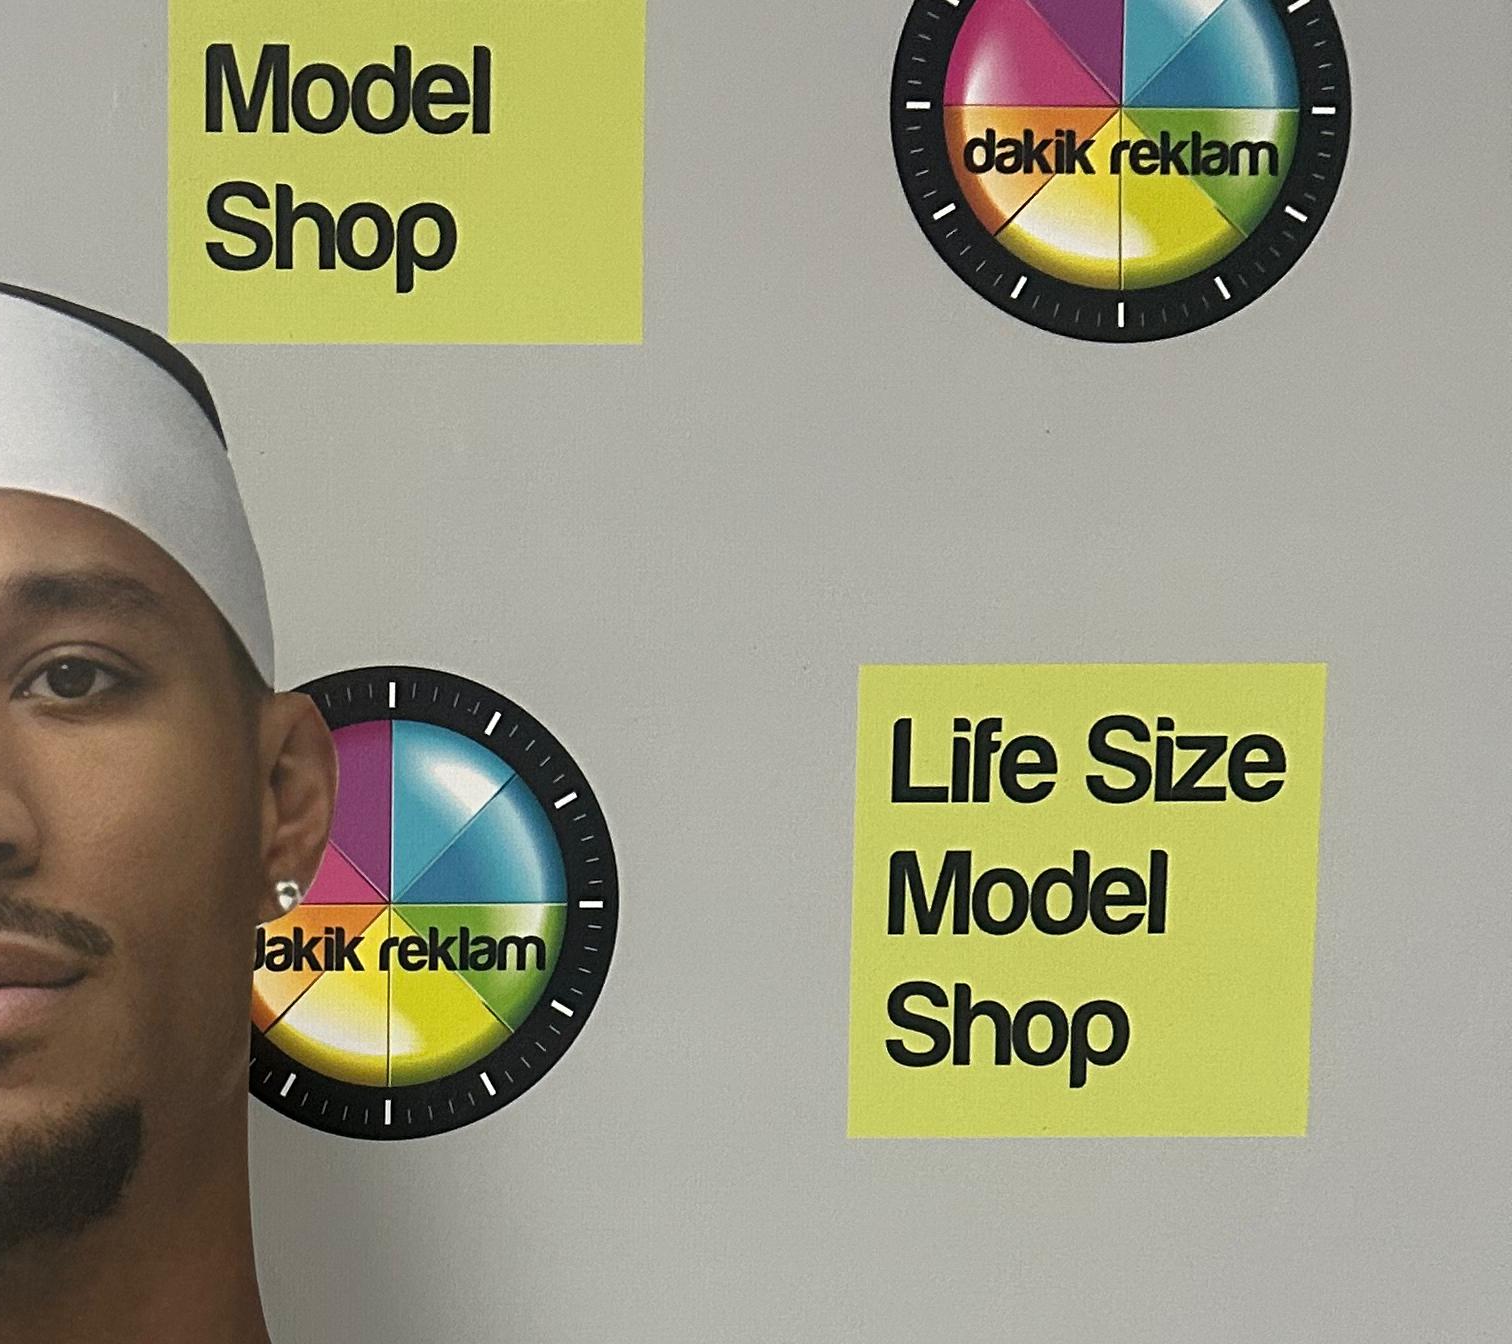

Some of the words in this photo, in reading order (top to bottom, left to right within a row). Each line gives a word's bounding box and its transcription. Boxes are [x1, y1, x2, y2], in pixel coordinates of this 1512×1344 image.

[205, 43, 491, 135] Model
[963, 128, 1096, 175] dakik
[1110, 130, 1279, 178] reklam
[205, 181, 457, 294] Shop
[891, 717, 1058, 804] Life
[1085, 714, 1287, 804] Size
[887, 849, 1168, 936] Model
[379, 926, 547, 972] reklam
[885, 980, 1130, 1089] Shop
